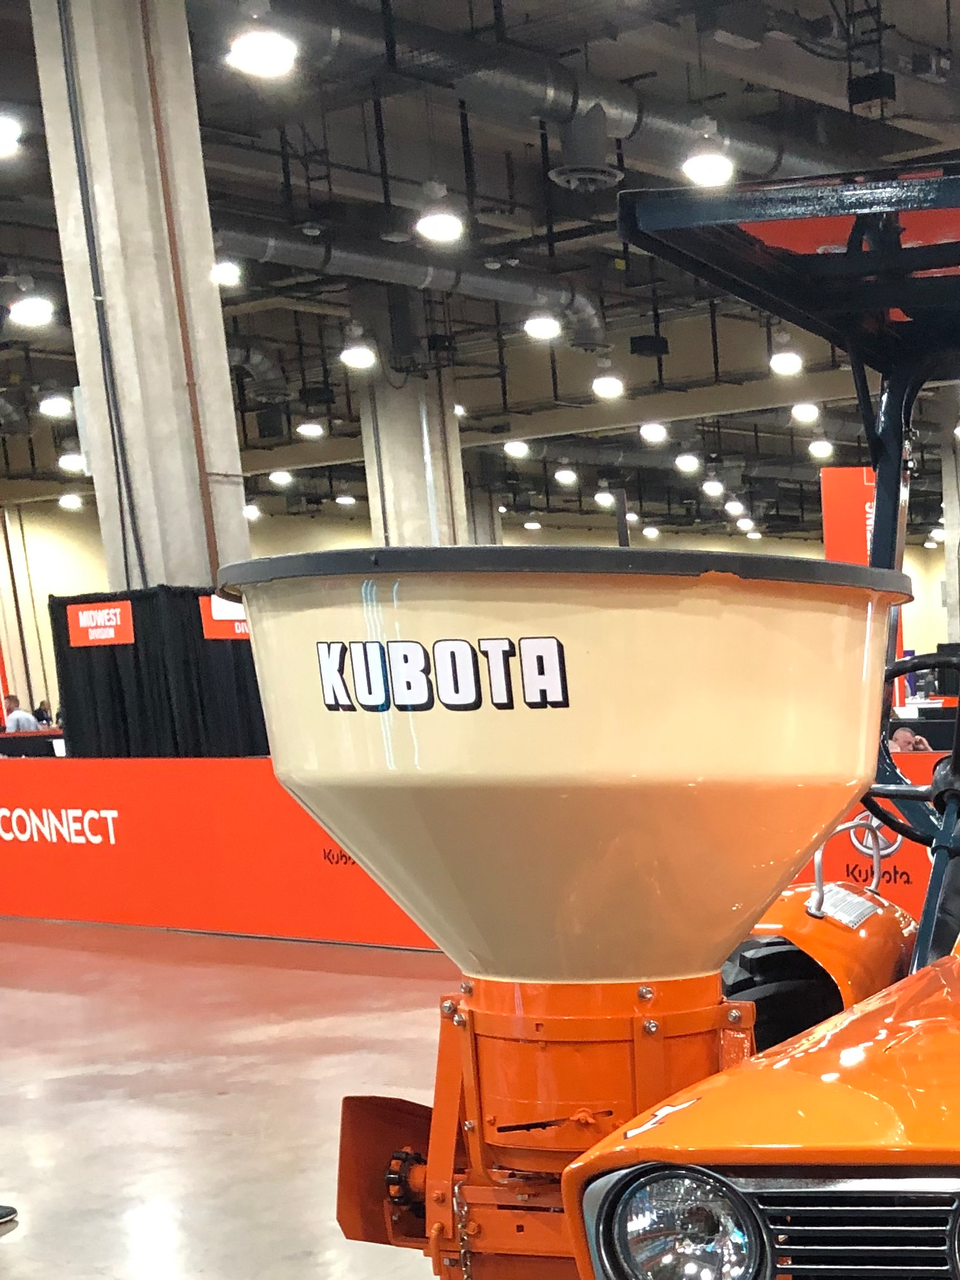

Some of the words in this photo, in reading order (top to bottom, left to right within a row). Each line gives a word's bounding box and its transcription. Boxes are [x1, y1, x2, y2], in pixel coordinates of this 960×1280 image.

[78, 608, 121, 628] MIDWEST
[88, 627, 115, 640] DIVISION
[316, 636, 570, 712] KUBOTA
[0, 807, 119, 845] CONNECT
